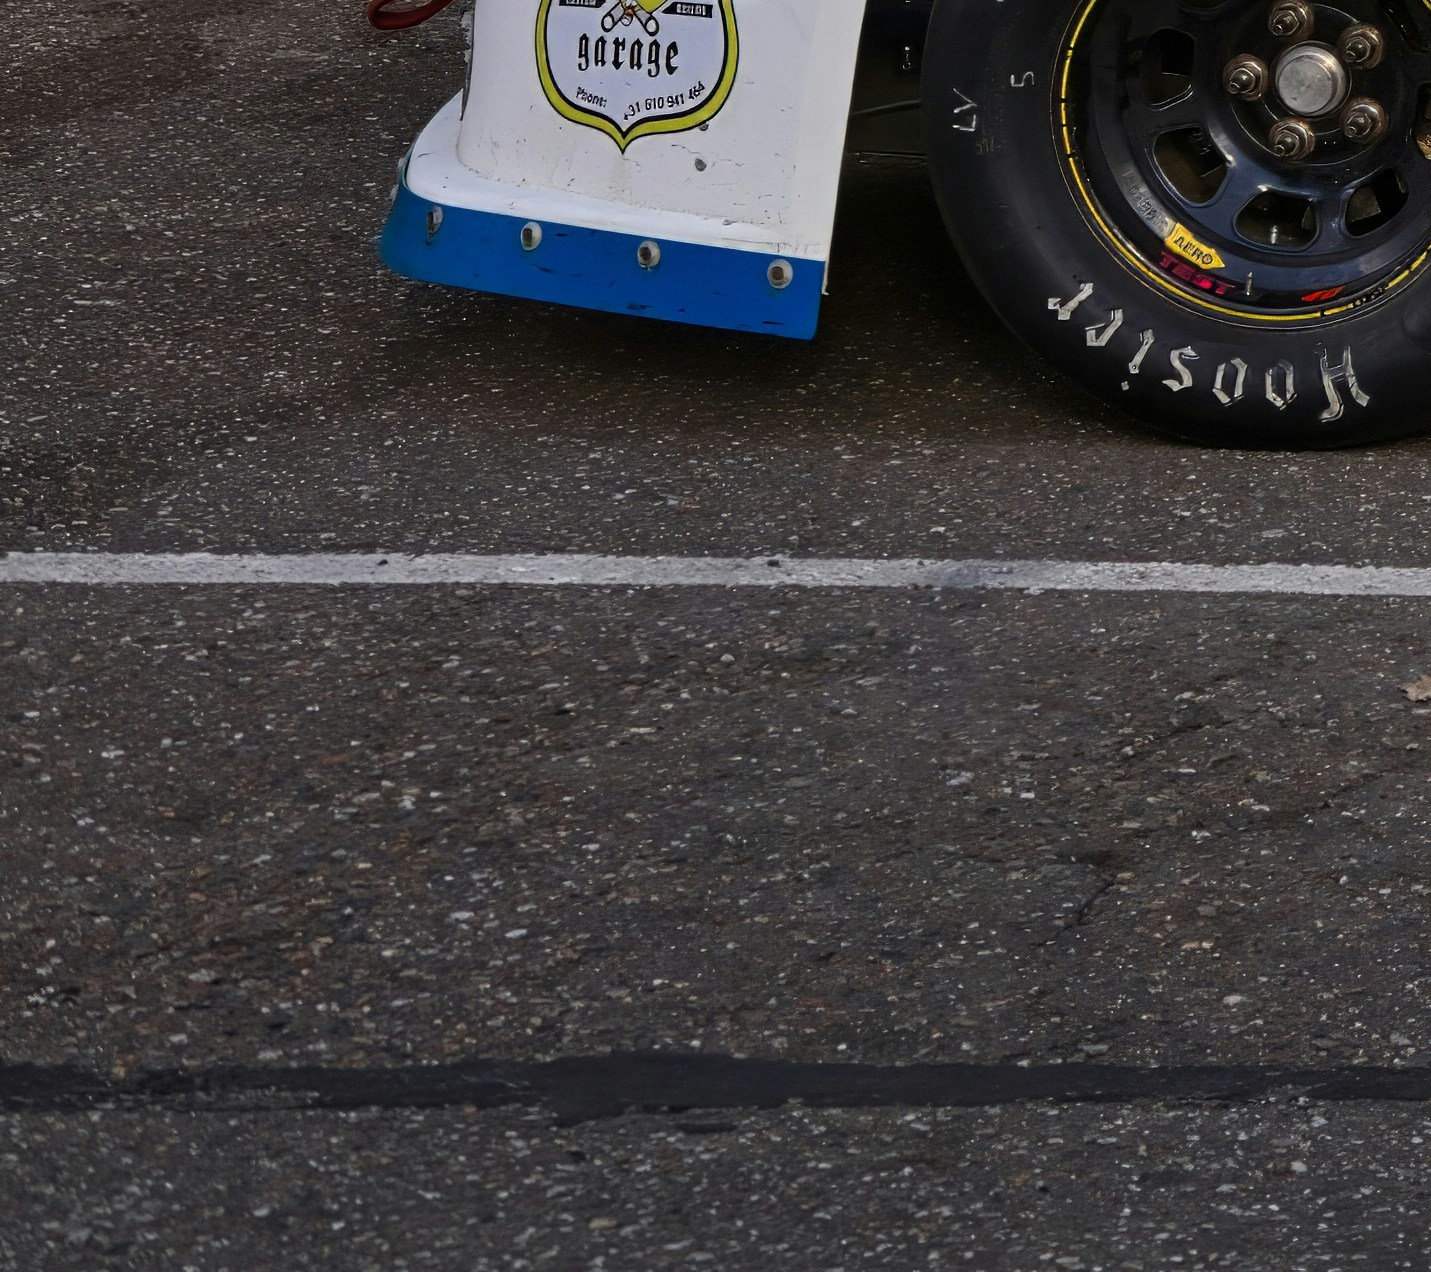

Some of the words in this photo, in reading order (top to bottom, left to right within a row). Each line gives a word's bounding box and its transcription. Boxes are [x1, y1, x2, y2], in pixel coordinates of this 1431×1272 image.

[578, 33, 679, 78] garage
[1174, 236, 1214, 265] AERO
[1047, 282, 1370, 424] Hoosier
